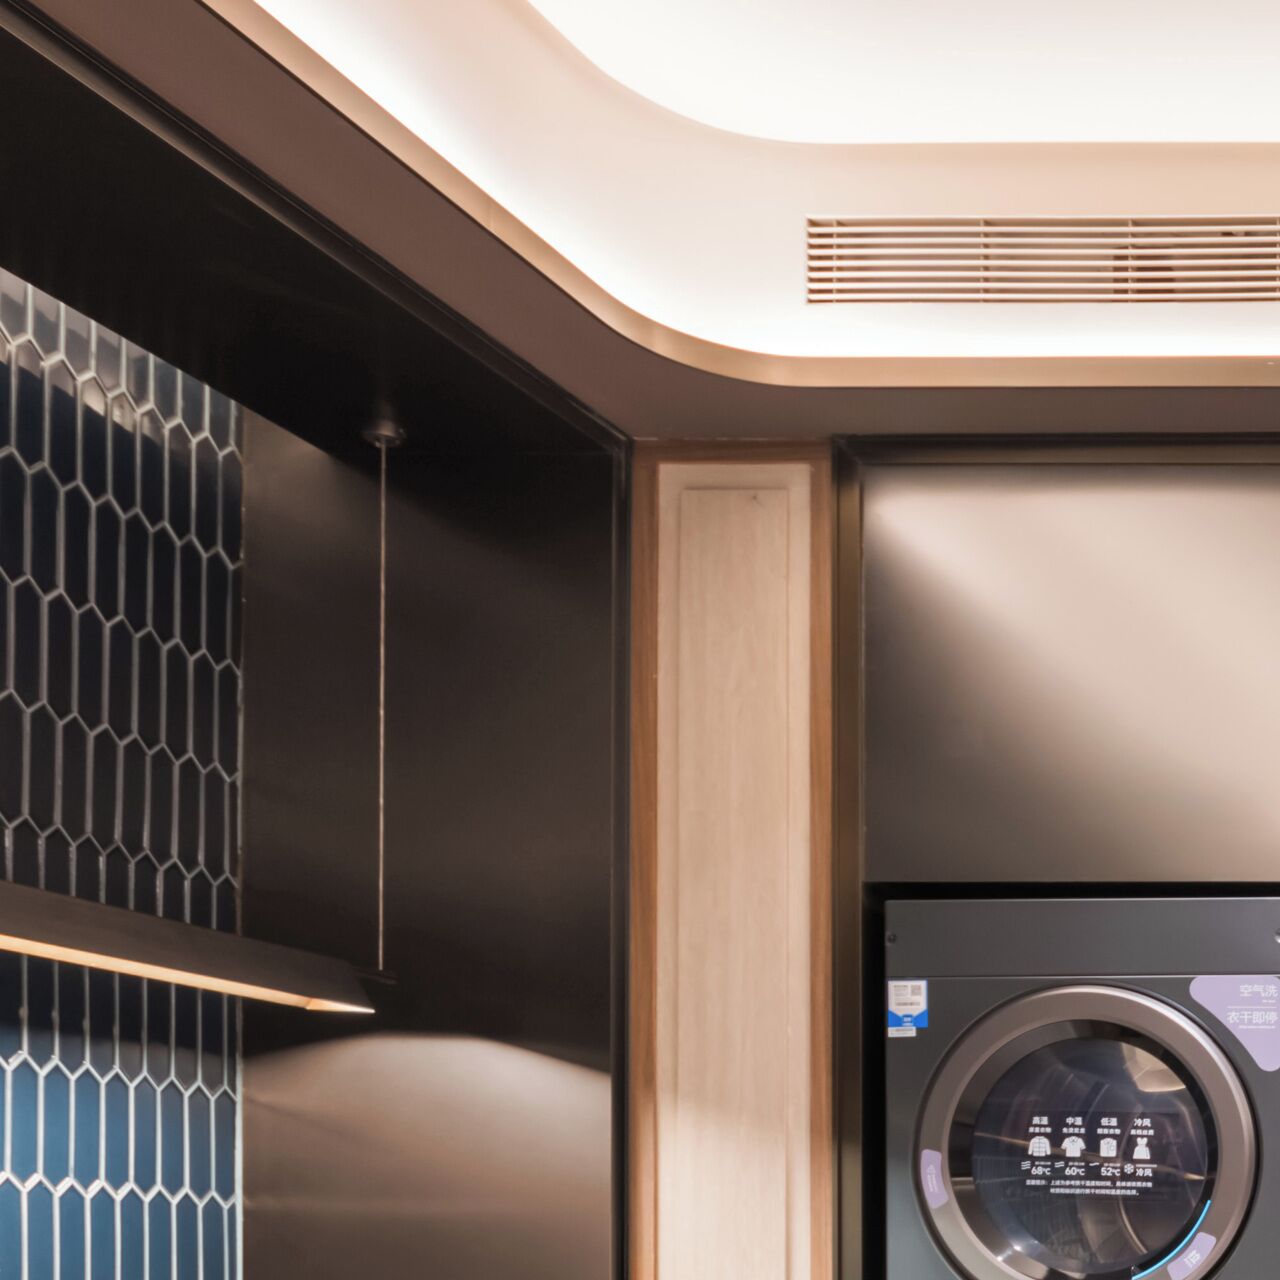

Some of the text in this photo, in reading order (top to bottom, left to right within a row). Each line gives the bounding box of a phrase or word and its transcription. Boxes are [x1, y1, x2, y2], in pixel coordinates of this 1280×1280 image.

[1240, 985, 1278, 997] 空气洗
[1227, 1011, 1278, 1024] 衣干即停
[1032, 1117, 1048, 1125] 高温
[1066, 1117, 1082, 1125] 中温
[1101, 1118, 1117, 1126] 低温
[1134, 1118, 1151, 1127] 冷风
